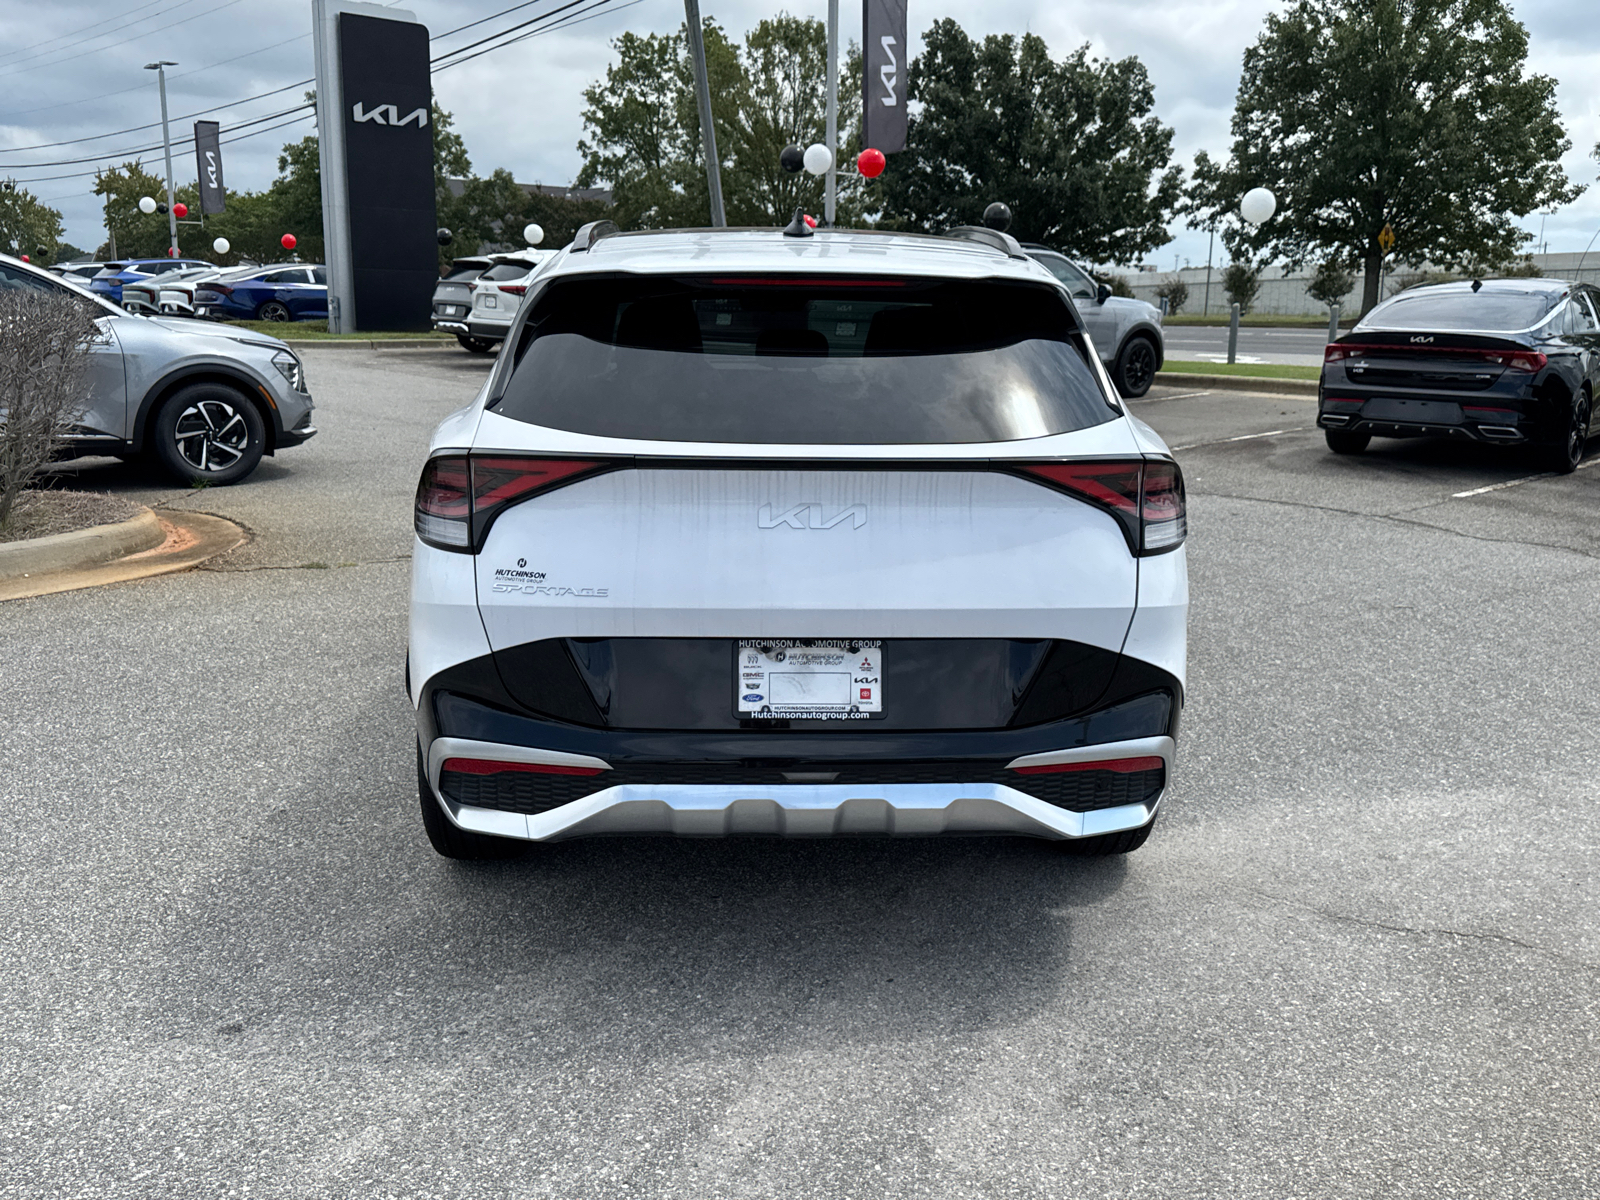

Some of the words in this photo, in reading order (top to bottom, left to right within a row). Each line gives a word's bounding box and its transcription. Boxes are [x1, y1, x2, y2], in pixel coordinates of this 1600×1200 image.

[881, 36, 897, 106] KIA
[353, 102, 428, 128] KIA
[205, 151, 218, 188] KIA
[757, 502, 867, 530] KIA
[495, 569, 546, 579] HUTCHINSON
[492, 582, 609, 597] SPORTAGE
[739, 640, 793, 648] HUTCHINSON
[795, 640, 850, 648] AOMOTIVE
[852, 640, 881, 648] GROUP
[751, 711, 870, 720] Hutchinsonautogroup.com
